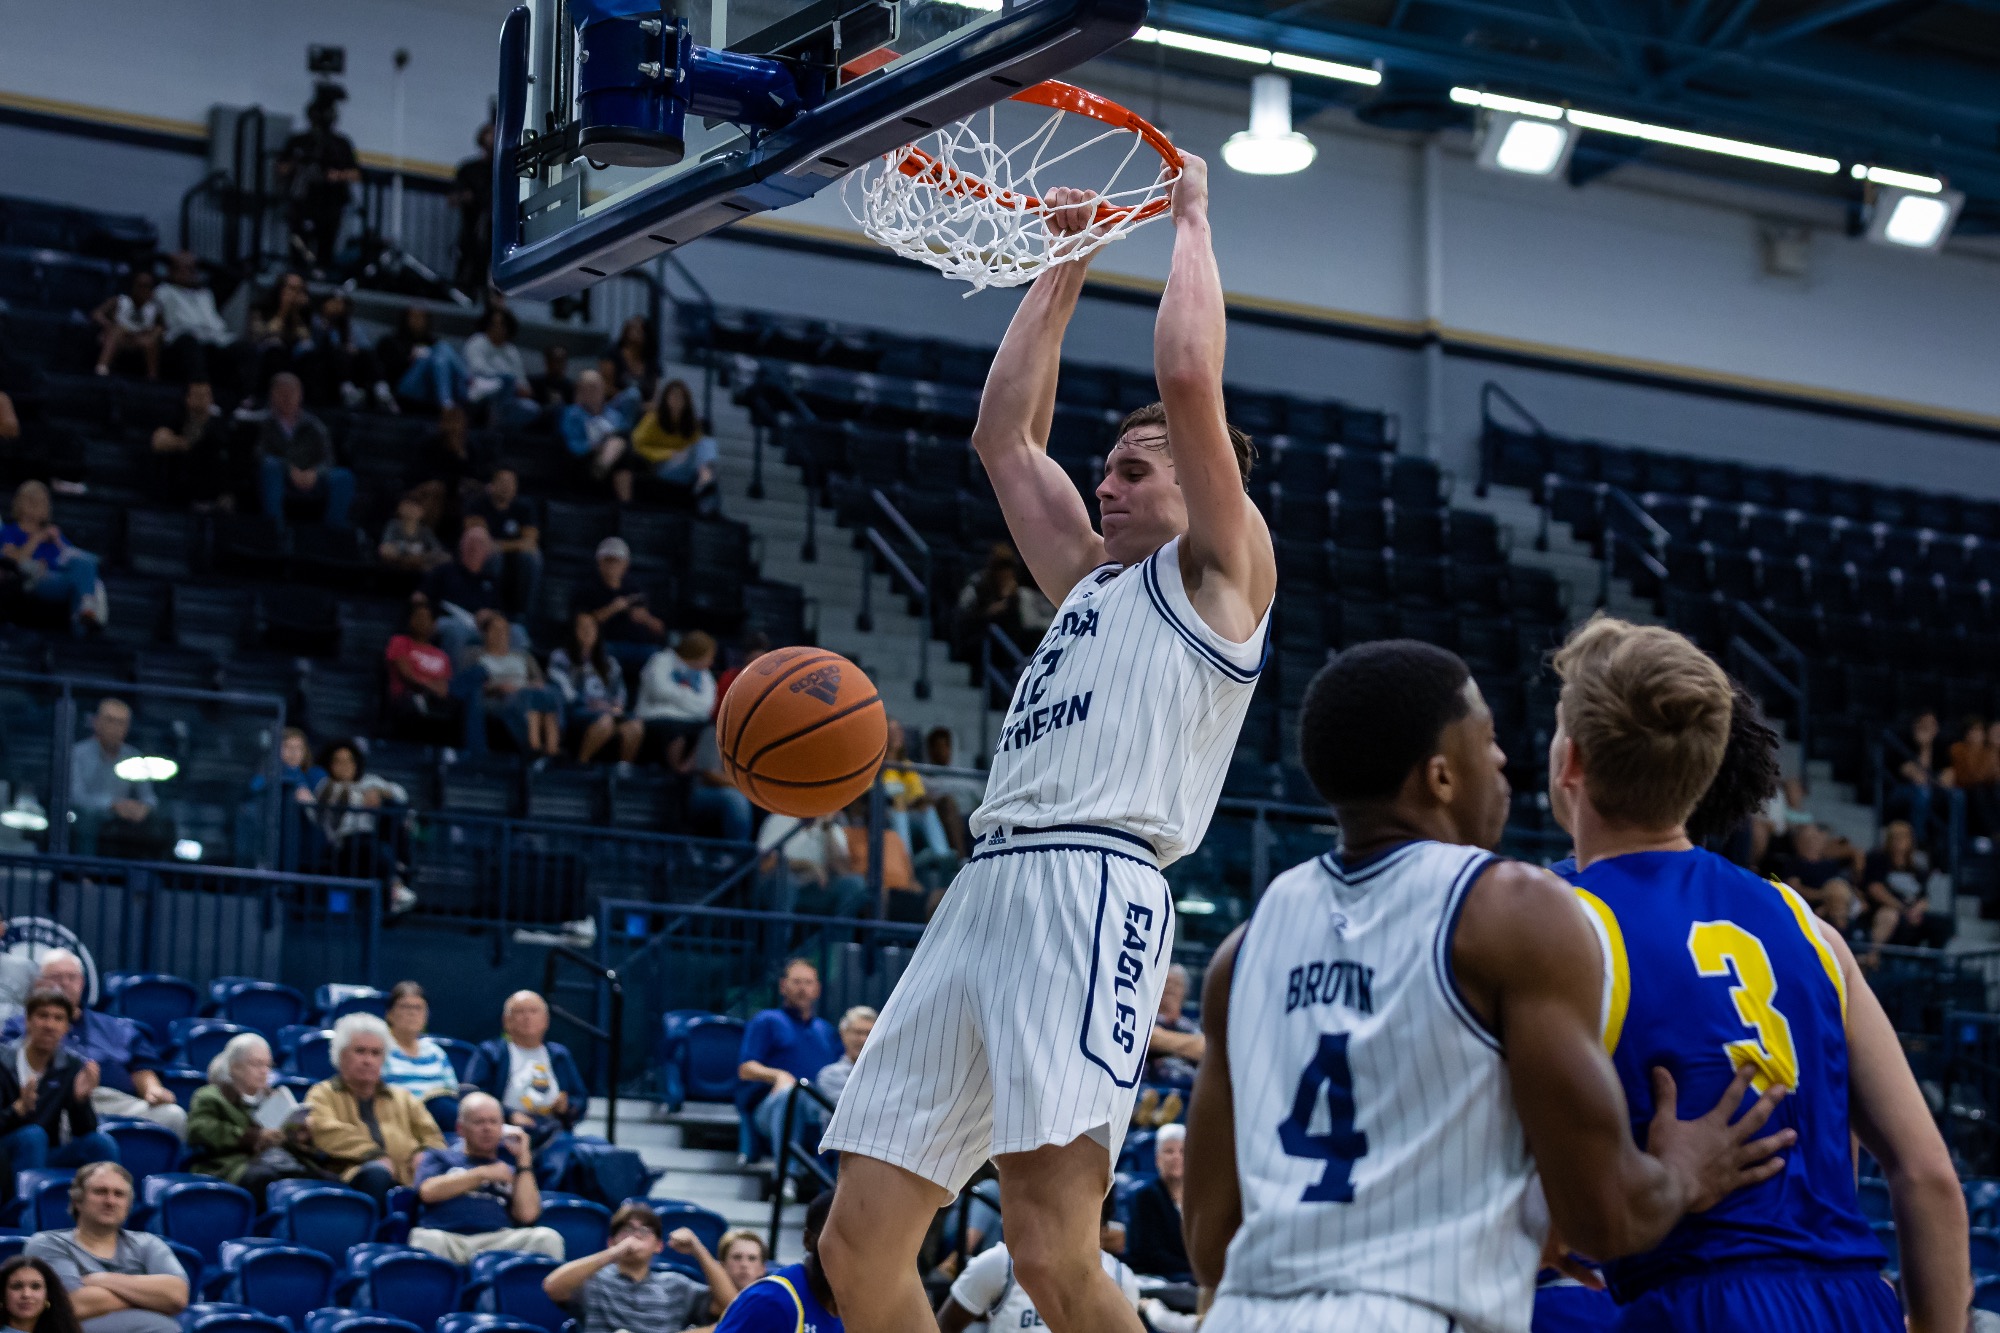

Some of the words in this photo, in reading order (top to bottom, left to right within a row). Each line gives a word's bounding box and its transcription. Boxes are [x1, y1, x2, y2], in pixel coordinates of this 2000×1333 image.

[987, 837, 1007, 846] adidas
[1113, 901, 1153, 1054] EAGLES
[1687, 920, 1799, 1094] 3
[1277, 1031, 1369, 1202] 4
